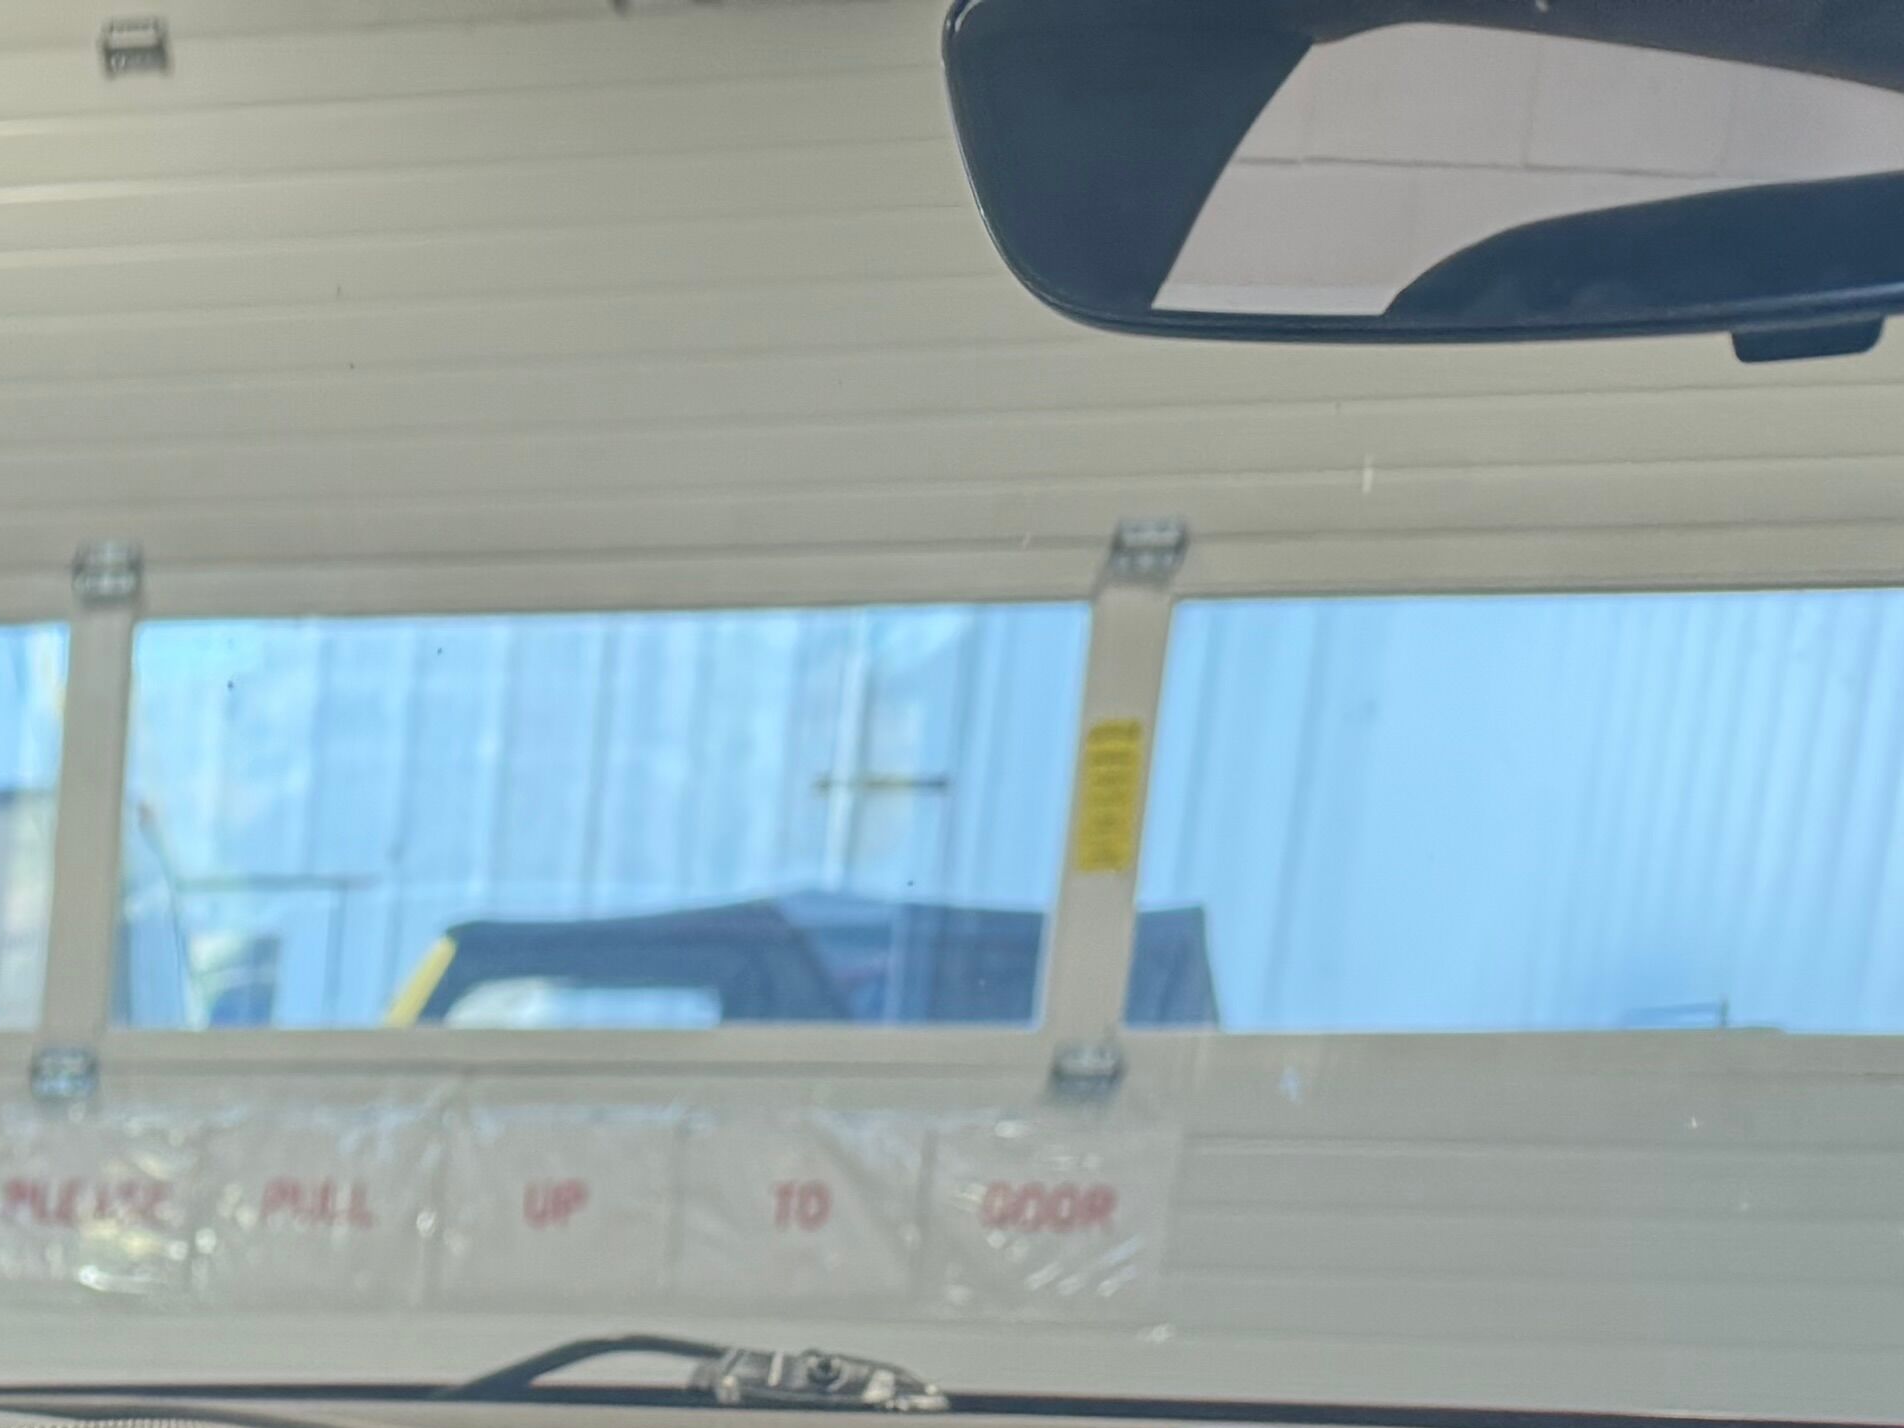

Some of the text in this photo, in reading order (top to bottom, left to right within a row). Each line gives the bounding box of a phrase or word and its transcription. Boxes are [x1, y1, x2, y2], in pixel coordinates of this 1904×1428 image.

[261, 1177, 374, 1229] PULL
[523, 1176, 589, 1230] UP
[773, 1177, 833, 1232] TO
